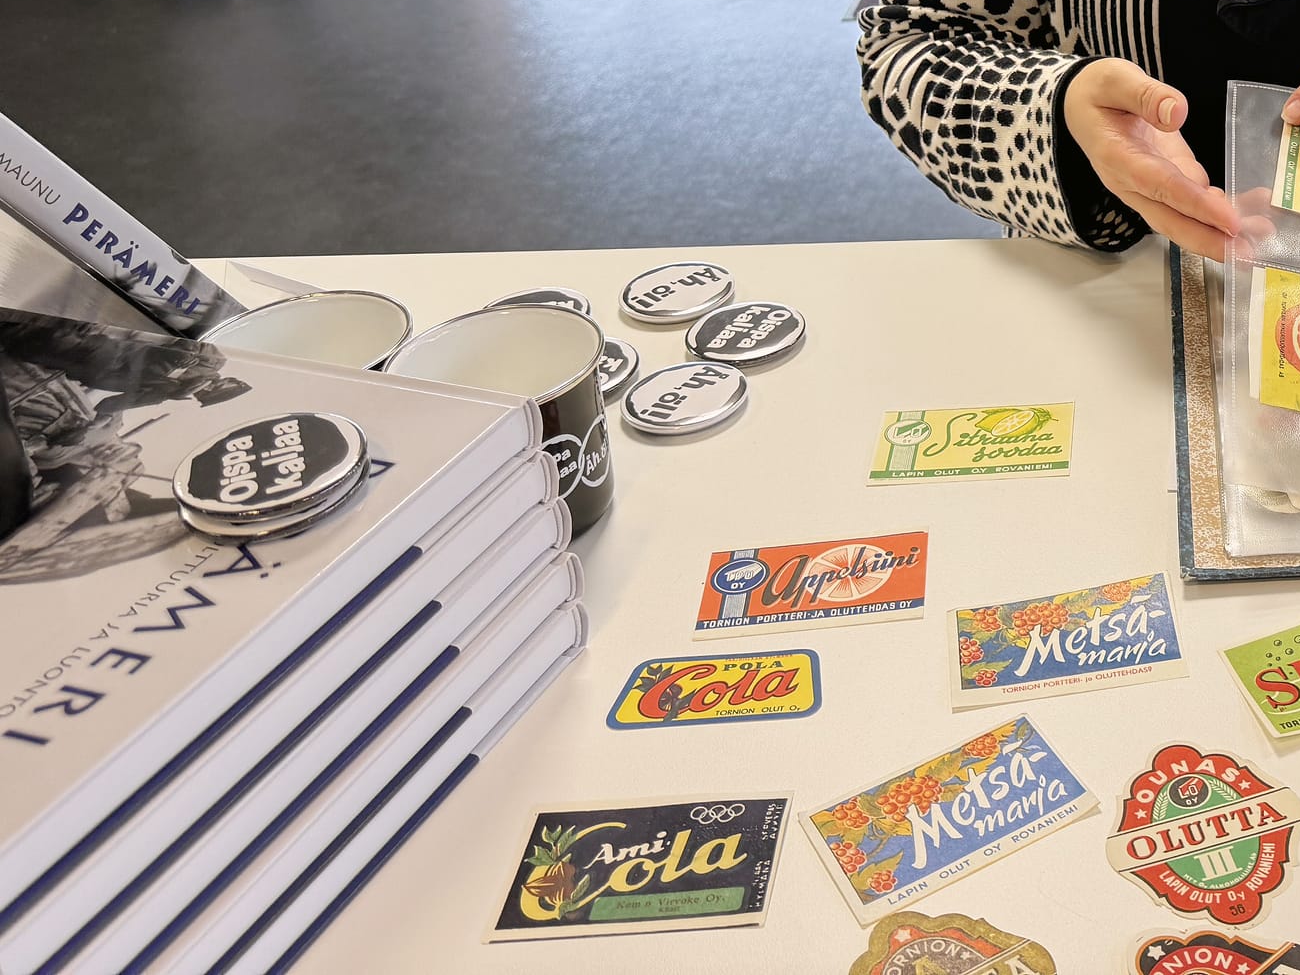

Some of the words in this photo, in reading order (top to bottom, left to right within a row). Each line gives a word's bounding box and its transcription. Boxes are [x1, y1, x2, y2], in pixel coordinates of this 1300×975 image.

[0, 153, 61, 206] MAUNU
[62, 202, 202, 315] PERÄMERI
[706, 305, 771, 348] kaljaa
[737, 309, 792, 349] Oispa
[922, 412, 1055, 457] Sitruuna
[971, 443, 1063, 463] soodaa
[219, 433, 257, 503] Oispa
[266, 419, 305, 497] kaljaa
[892, 470, 924, 478] LAPIN
[934, 468, 961, 476] OLUT
[995, 463, 1053, 472] ROVANIEMI
[731, 581, 746, 590] OY
[760, 546, 920, 609] Appelsiini
[703, 617, 750, 629] TORNION
[830, 602, 896, 618] OLUTTEHDAS
[899, 600, 913, 609] OY
[723, 660, 784, 672] POLA
[1078, 630, 1167, 666] marja
[638, 664, 800, 719] Cola
[1002, 682, 1041, 694] TORNION
[715, 708, 756, 716] TORNION
[761, 705, 784, 715] OLUT
[1136, 759, 1240, 803] OUNAS
[1186, 796, 1199, 806] OY
[974, 774, 1068, 837] marja
[1127, 802, 1288, 860] OLUTTA
[888, 881, 928, 905] LAPIN
[939, 859, 971, 880] OLUT
[1012, 804, 1079, 844] ROVANIEMI
[1159, 871, 1190, 896] LAPIN
[1189, 889, 1222, 904] OLUT
[1246, 842, 1276, 892] ROVANIEMI
[1194, 845, 1243, 881] III
[886, 939, 960, 975] ORNION
[1157, 948, 1233, 975] NION
